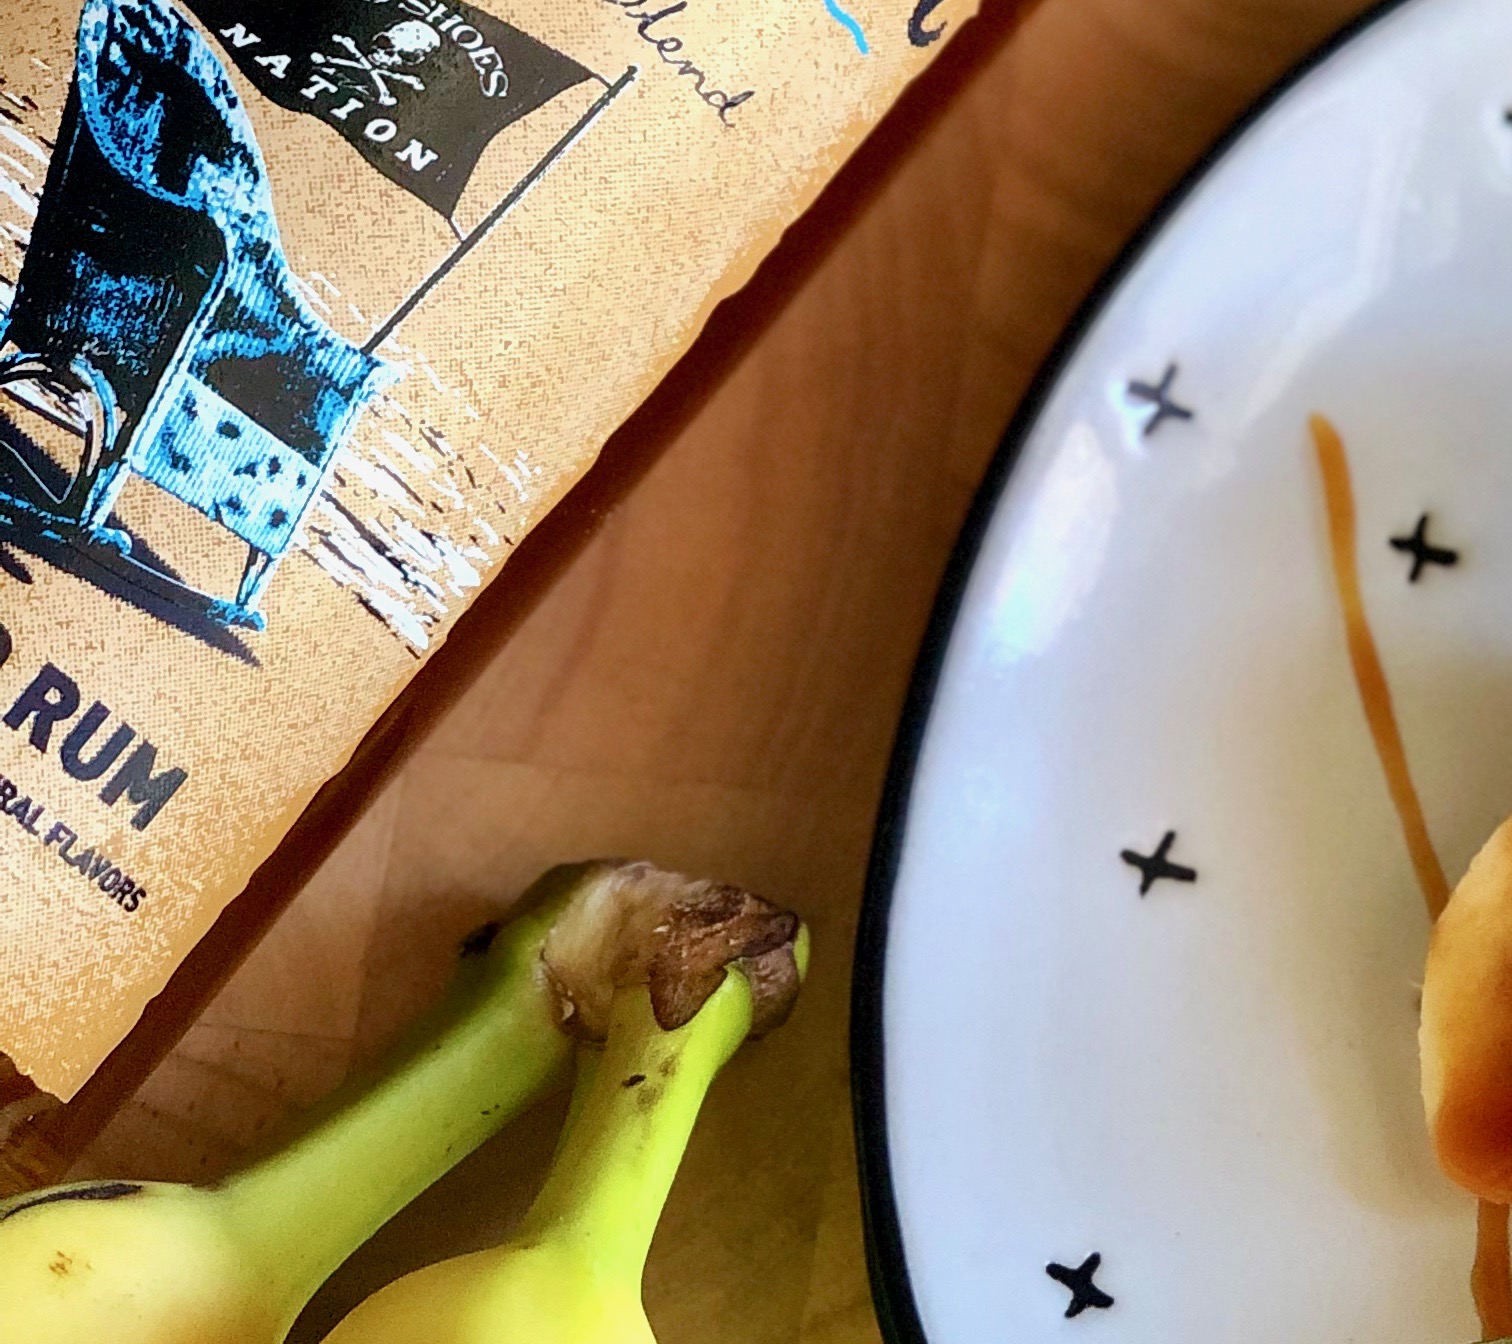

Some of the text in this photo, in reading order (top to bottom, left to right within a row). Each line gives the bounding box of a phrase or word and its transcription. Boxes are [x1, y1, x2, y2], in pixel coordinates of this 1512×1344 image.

[220, 22, 438, 171] NATION
[2, 661, 189, 832] RUM
[43, 820, 148, 913] FLAVORS
